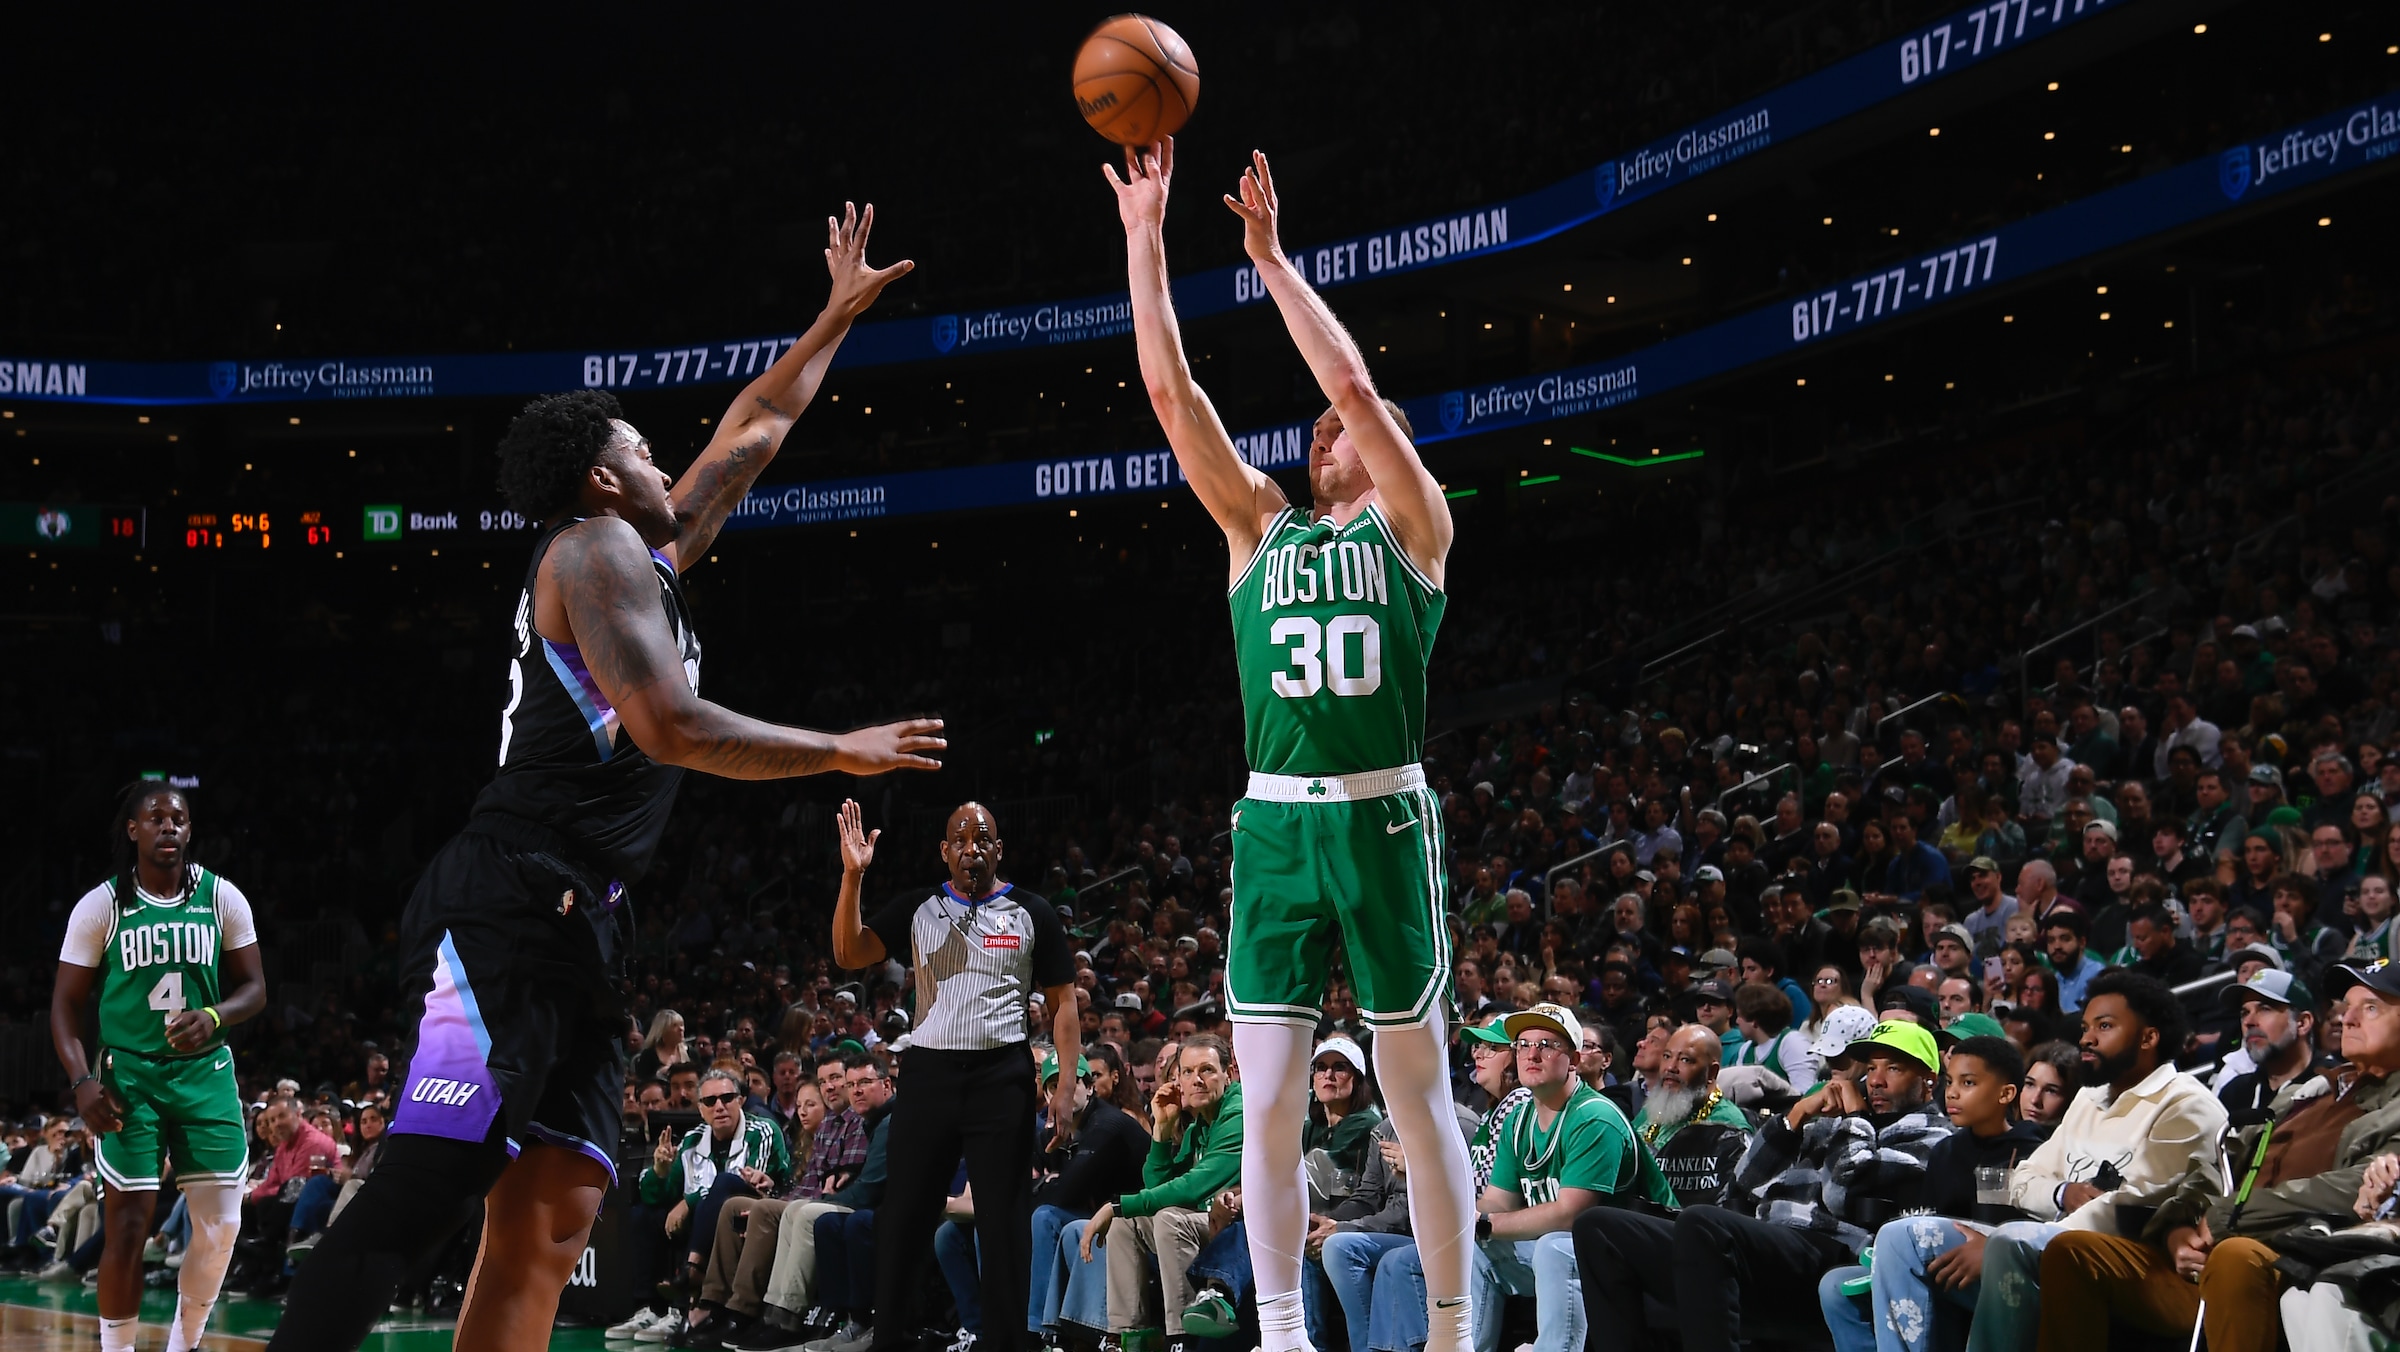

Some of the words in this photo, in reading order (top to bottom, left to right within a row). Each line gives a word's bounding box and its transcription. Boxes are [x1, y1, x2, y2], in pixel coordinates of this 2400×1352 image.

[1900, 0, 2103, 84] 617-777-
[1618, 148, 1675, 195] Jeffrey
[1676, 108, 1770, 164] Glassman
[2255, 130, 2343, 186] Jeffrey
[2346, 105, 2400, 146] Gla
[1235, 253, 1306, 303] GOA
[1316, 242, 1359, 286] GET
[1367, 206, 1508, 274] GLASSMAN
[1792, 236, 1998, 342] 617-777-7777
[961, 312, 1032, 346] Jeffrey
[1049, 330, 1089, 344] INJURY
[1093, 321, 1133, 338] LAWYER
[240, 363, 316, 393] Jeffrey
[318, 361, 433, 386] Glassman
[333, 387, 374, 398] INJURY
[379, 386, 434, 397] LAWYERS
[1467, 385, 1536, 424] Jeffrey
[1538, 365, 1637, 404] Glassman
[1551, 399, 1591, 417] INJURY
[1036, 457, 1116, 497] GOTTA
[1126, 451, 1171, 489] GET
[728, 491, 782, 520] ffrey
[784, 485, 885, 512] Glassman
[797, 510, 833, 524] INJURY
[838, 506, 886, 520] LAWYERS
[307, 525, 330, 546] 67
[368, 510, 399, 534] TD
[410, 511, 458, 530] Bank
[1340, 518, 1372, 539] mica
[1260, 540, 1388, 612] BOSTON
[1270, 614, 1381, 698] 30
[120, 922, 215, 972] BOSTON
[984, 937, 1020, 947] Emirates
[147, 971, 187, 1026] 4
[411, 1077, 481, 1107] UTAH
[1655, 1156, 1719, 1172] FRANKLIN
[1668, 1173, 1719, 1191] PLETON
